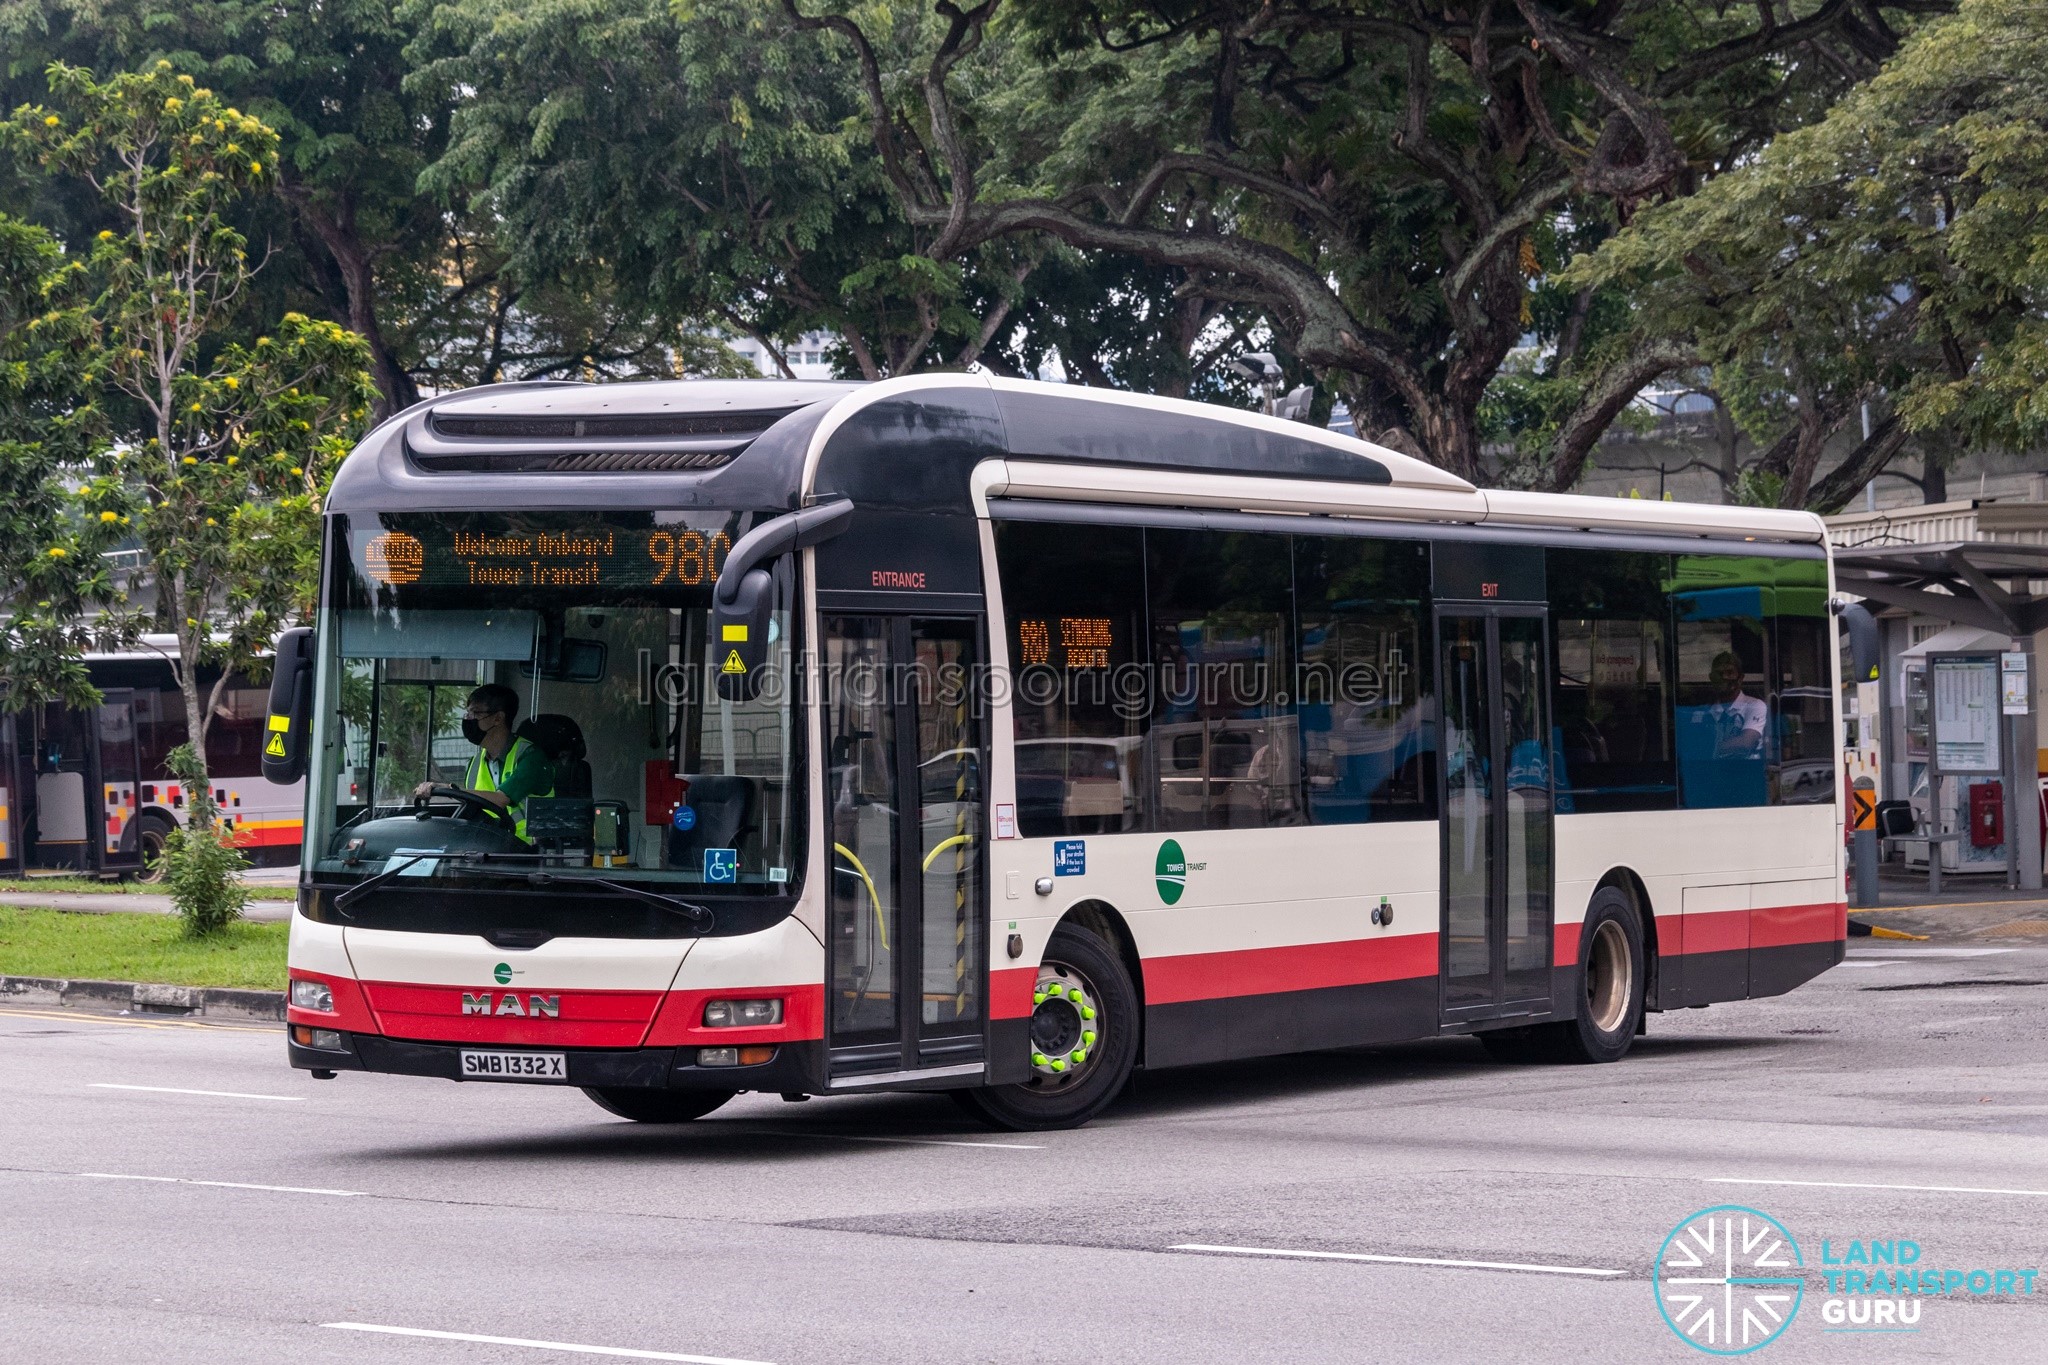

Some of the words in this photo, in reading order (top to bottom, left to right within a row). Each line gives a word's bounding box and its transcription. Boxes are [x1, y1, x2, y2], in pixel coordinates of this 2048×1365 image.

[455, 532, 532, 555] Welcome
[537, 532, 613, 555] Onboard
[468, 561, 523, 584] Tower
[530, 561, 600, 584] Transit
[872, 571, 925, 588] ENTRANCE
[1482, 583, 1498, 597] EXIT
[1020, 620, 1048, 664] 980
[1166, 863, 1185, 872] TOWER
[1187, 862, 1207, 871] TRANSIT
[462, 993, 559, 1018] MAN
